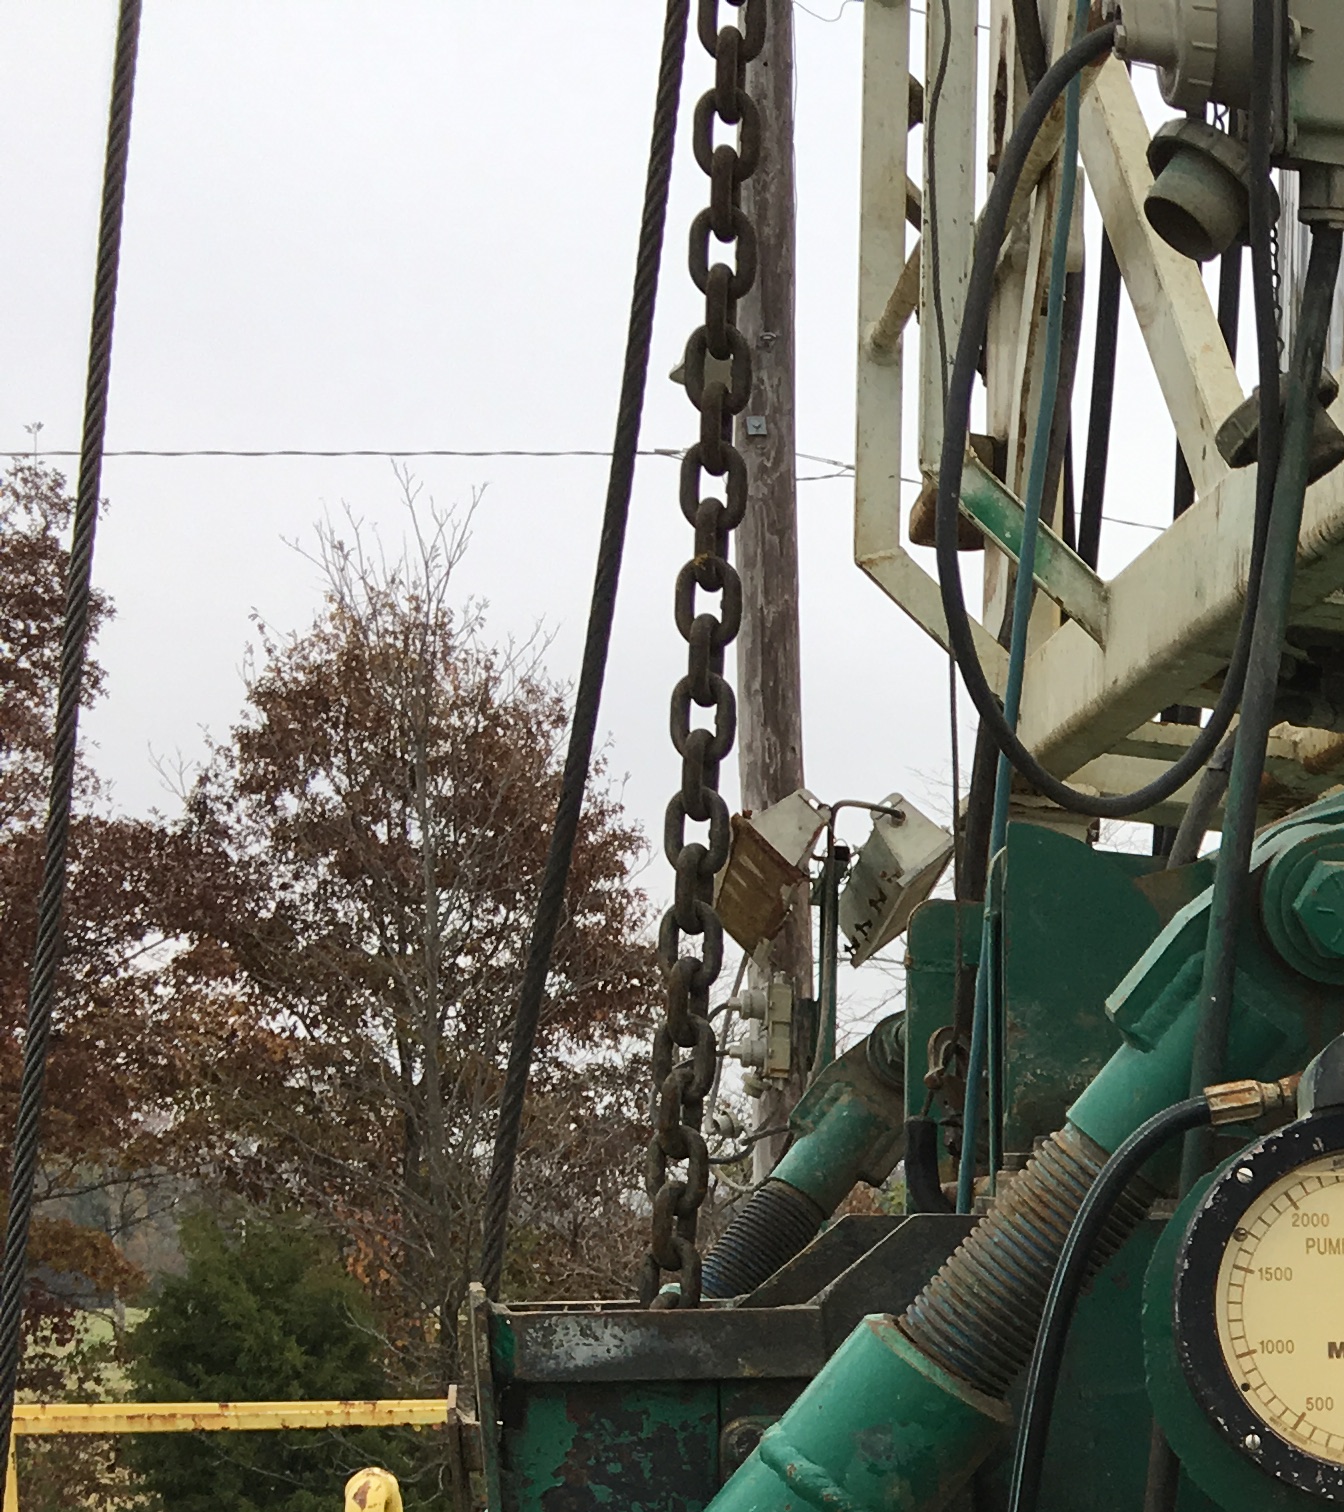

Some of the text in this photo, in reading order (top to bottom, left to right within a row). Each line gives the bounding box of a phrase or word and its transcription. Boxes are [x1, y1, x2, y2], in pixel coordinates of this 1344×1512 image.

[1291, 1213, 1330, 1227] 2000
[1258, 1266, 1293, 1282] 1500
[1259, 1339, 1295, 1355] 1000
[1305, 1396, 1334, 1412] 500
